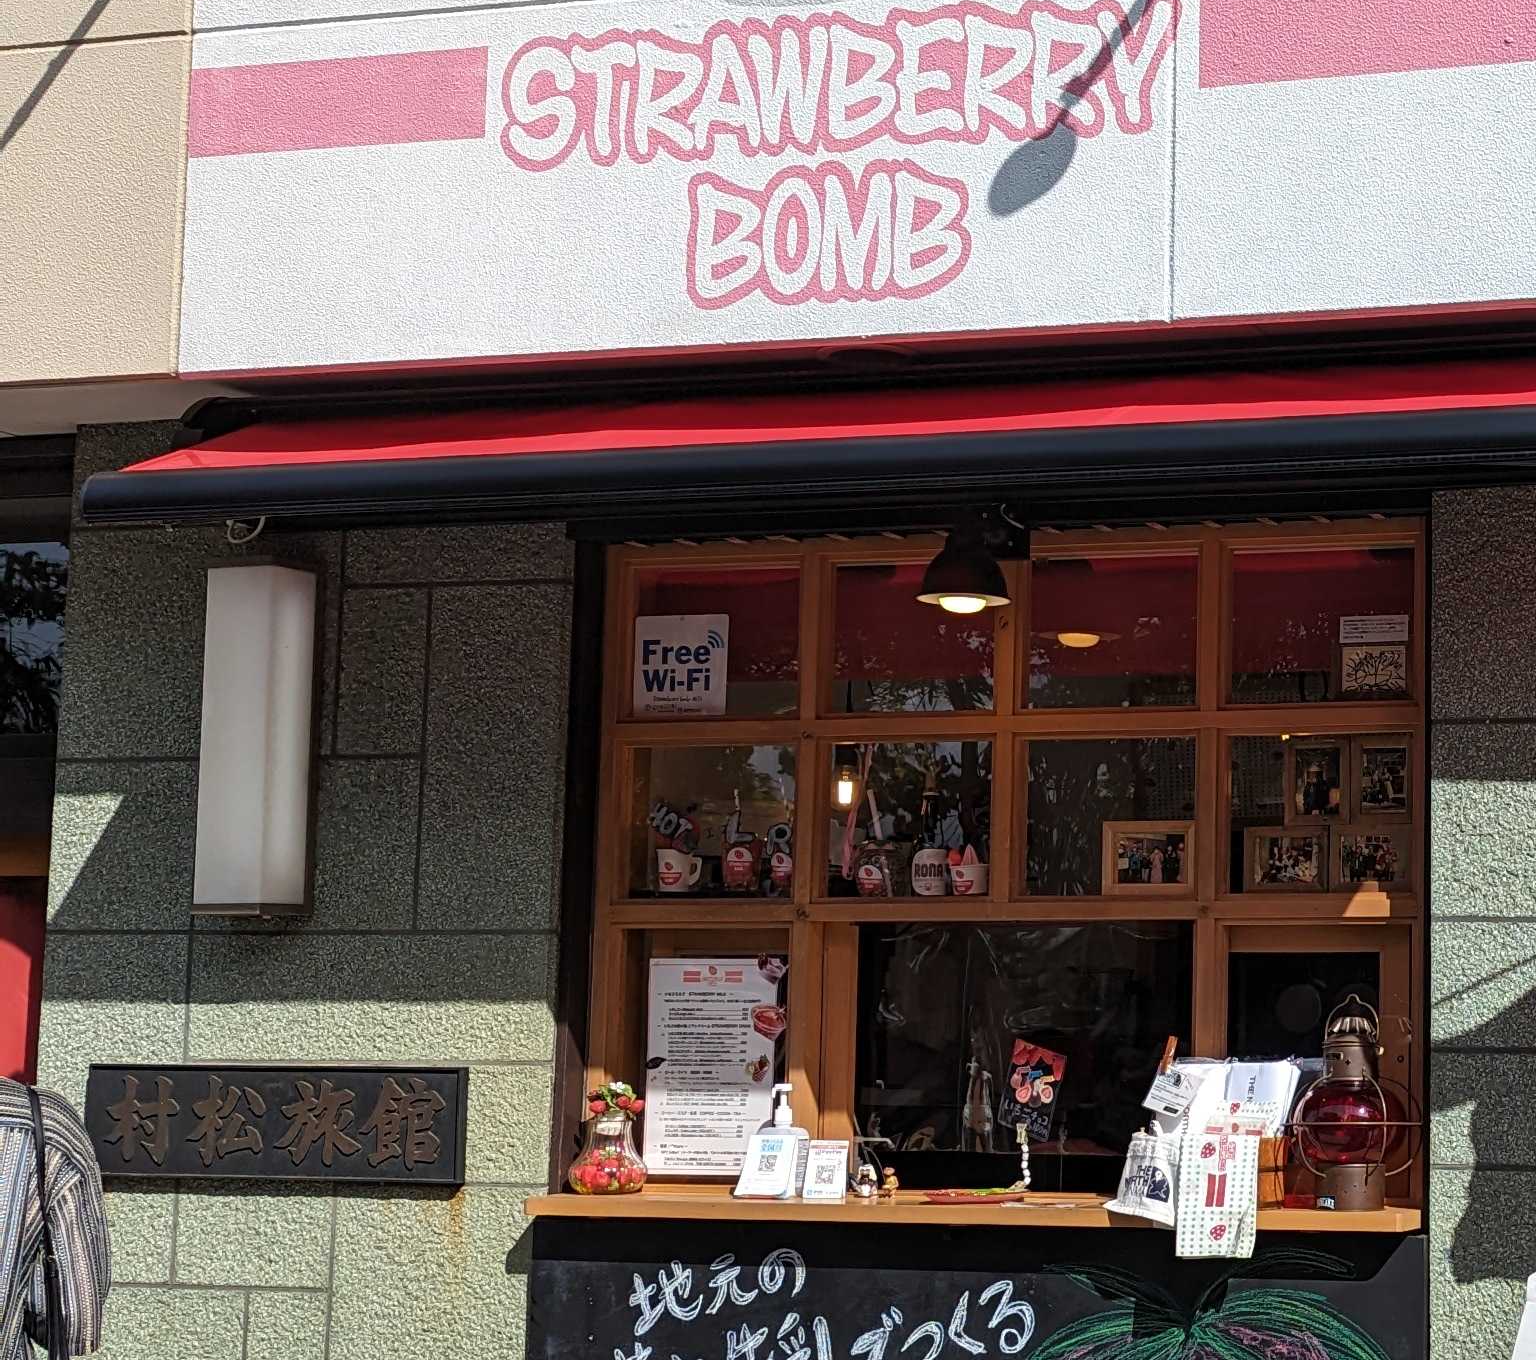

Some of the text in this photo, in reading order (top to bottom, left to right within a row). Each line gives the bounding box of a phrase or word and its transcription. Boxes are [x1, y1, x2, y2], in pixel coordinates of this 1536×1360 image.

[686, 159, 971, 310] BOMB
[642, 639, 711, 665] Free
[642, 668, 711, 692] Wi-Fi
[104, 1074, 447, 1169] 村松旅館
[627, 1247, 807, 1336] 地元の
